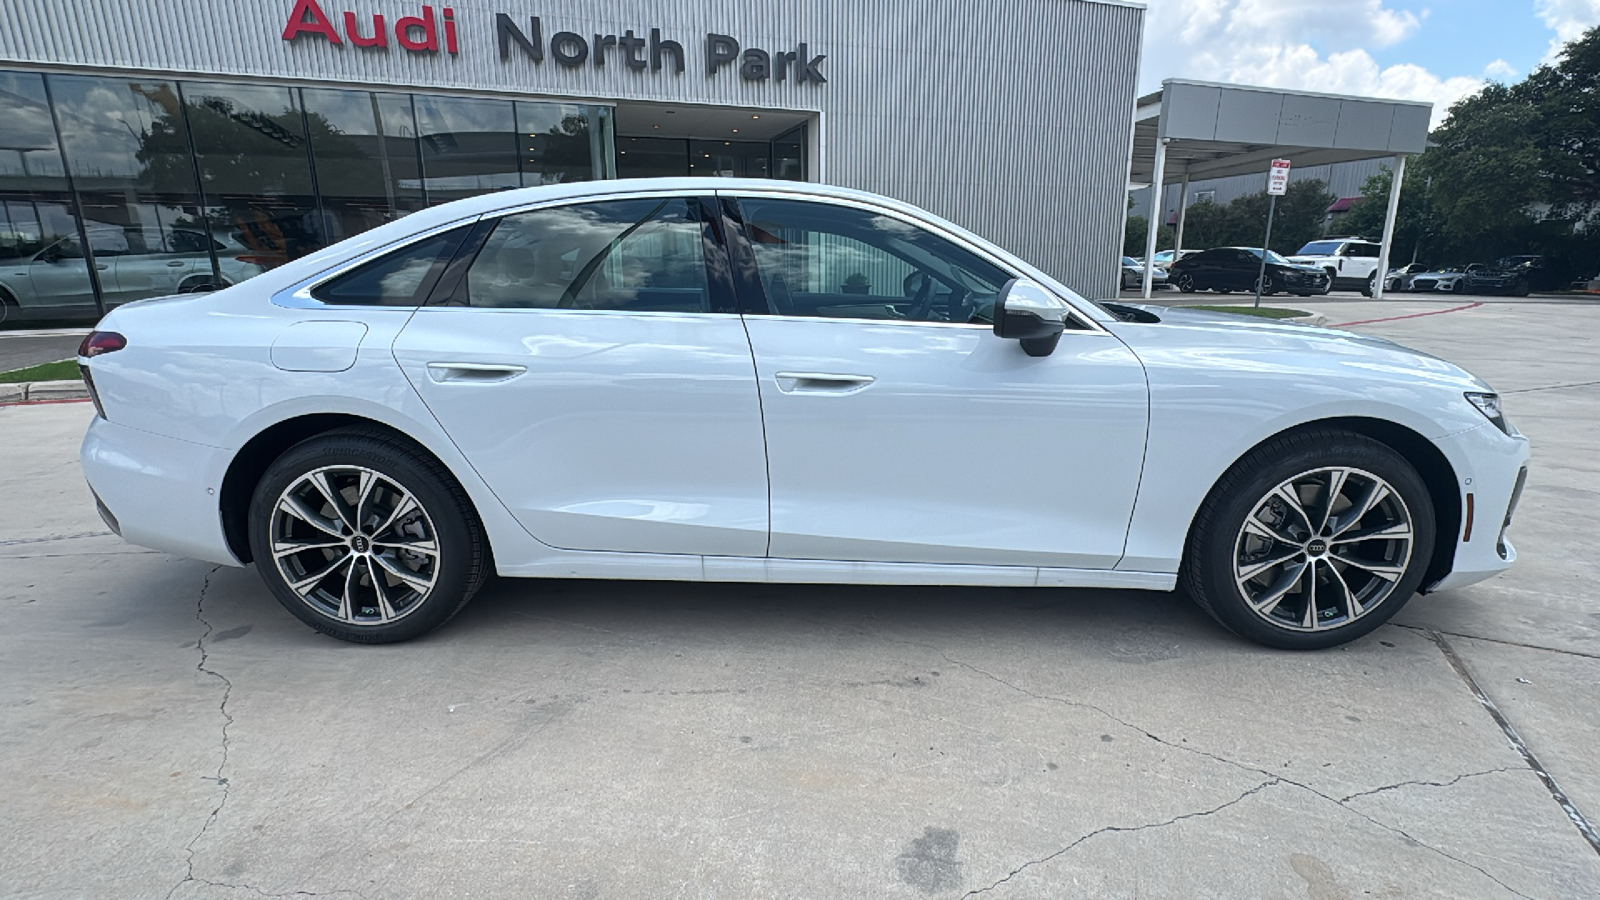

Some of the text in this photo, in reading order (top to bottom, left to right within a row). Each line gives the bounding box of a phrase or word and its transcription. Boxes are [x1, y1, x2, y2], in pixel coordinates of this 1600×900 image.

[282, 0, 828, 84] Audi North Park
